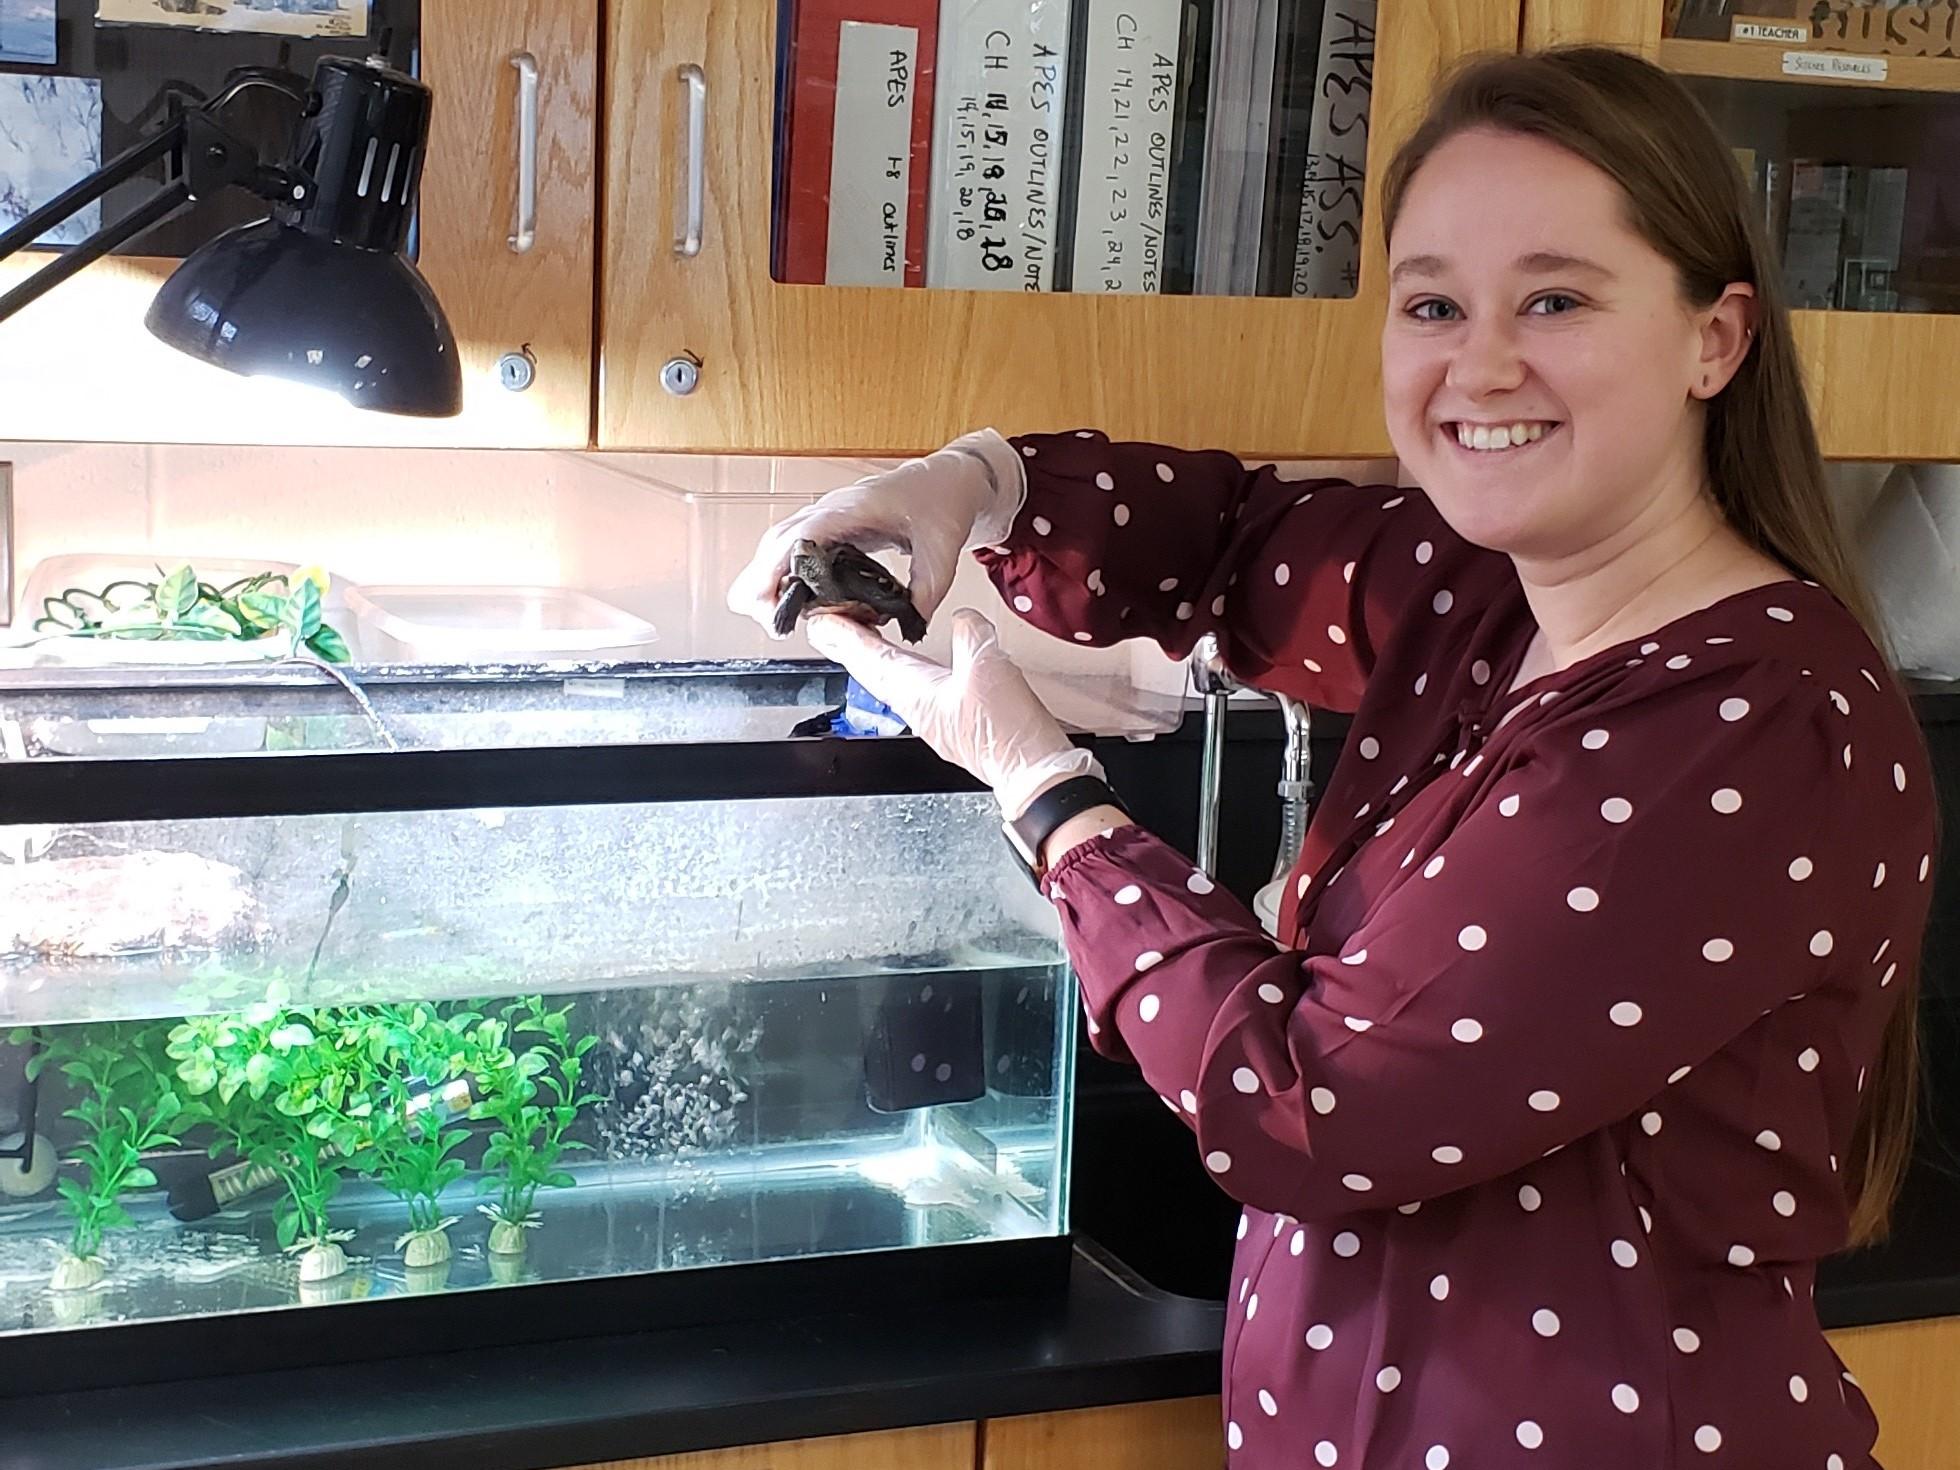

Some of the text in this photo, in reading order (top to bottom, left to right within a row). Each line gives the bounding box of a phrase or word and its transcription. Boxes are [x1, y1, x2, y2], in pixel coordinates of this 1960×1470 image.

[984, 30, 1011, 69] CH
[1115, 14, 1137, 50] CH
[1758, 27, 1799, 40] TEACHER
[887, 50, 908, 108] APES
[1030, 43, 1057, 112] APES
[1147, 52, 1174, 112] APES
[1323, 12, 1376, 138] APES
